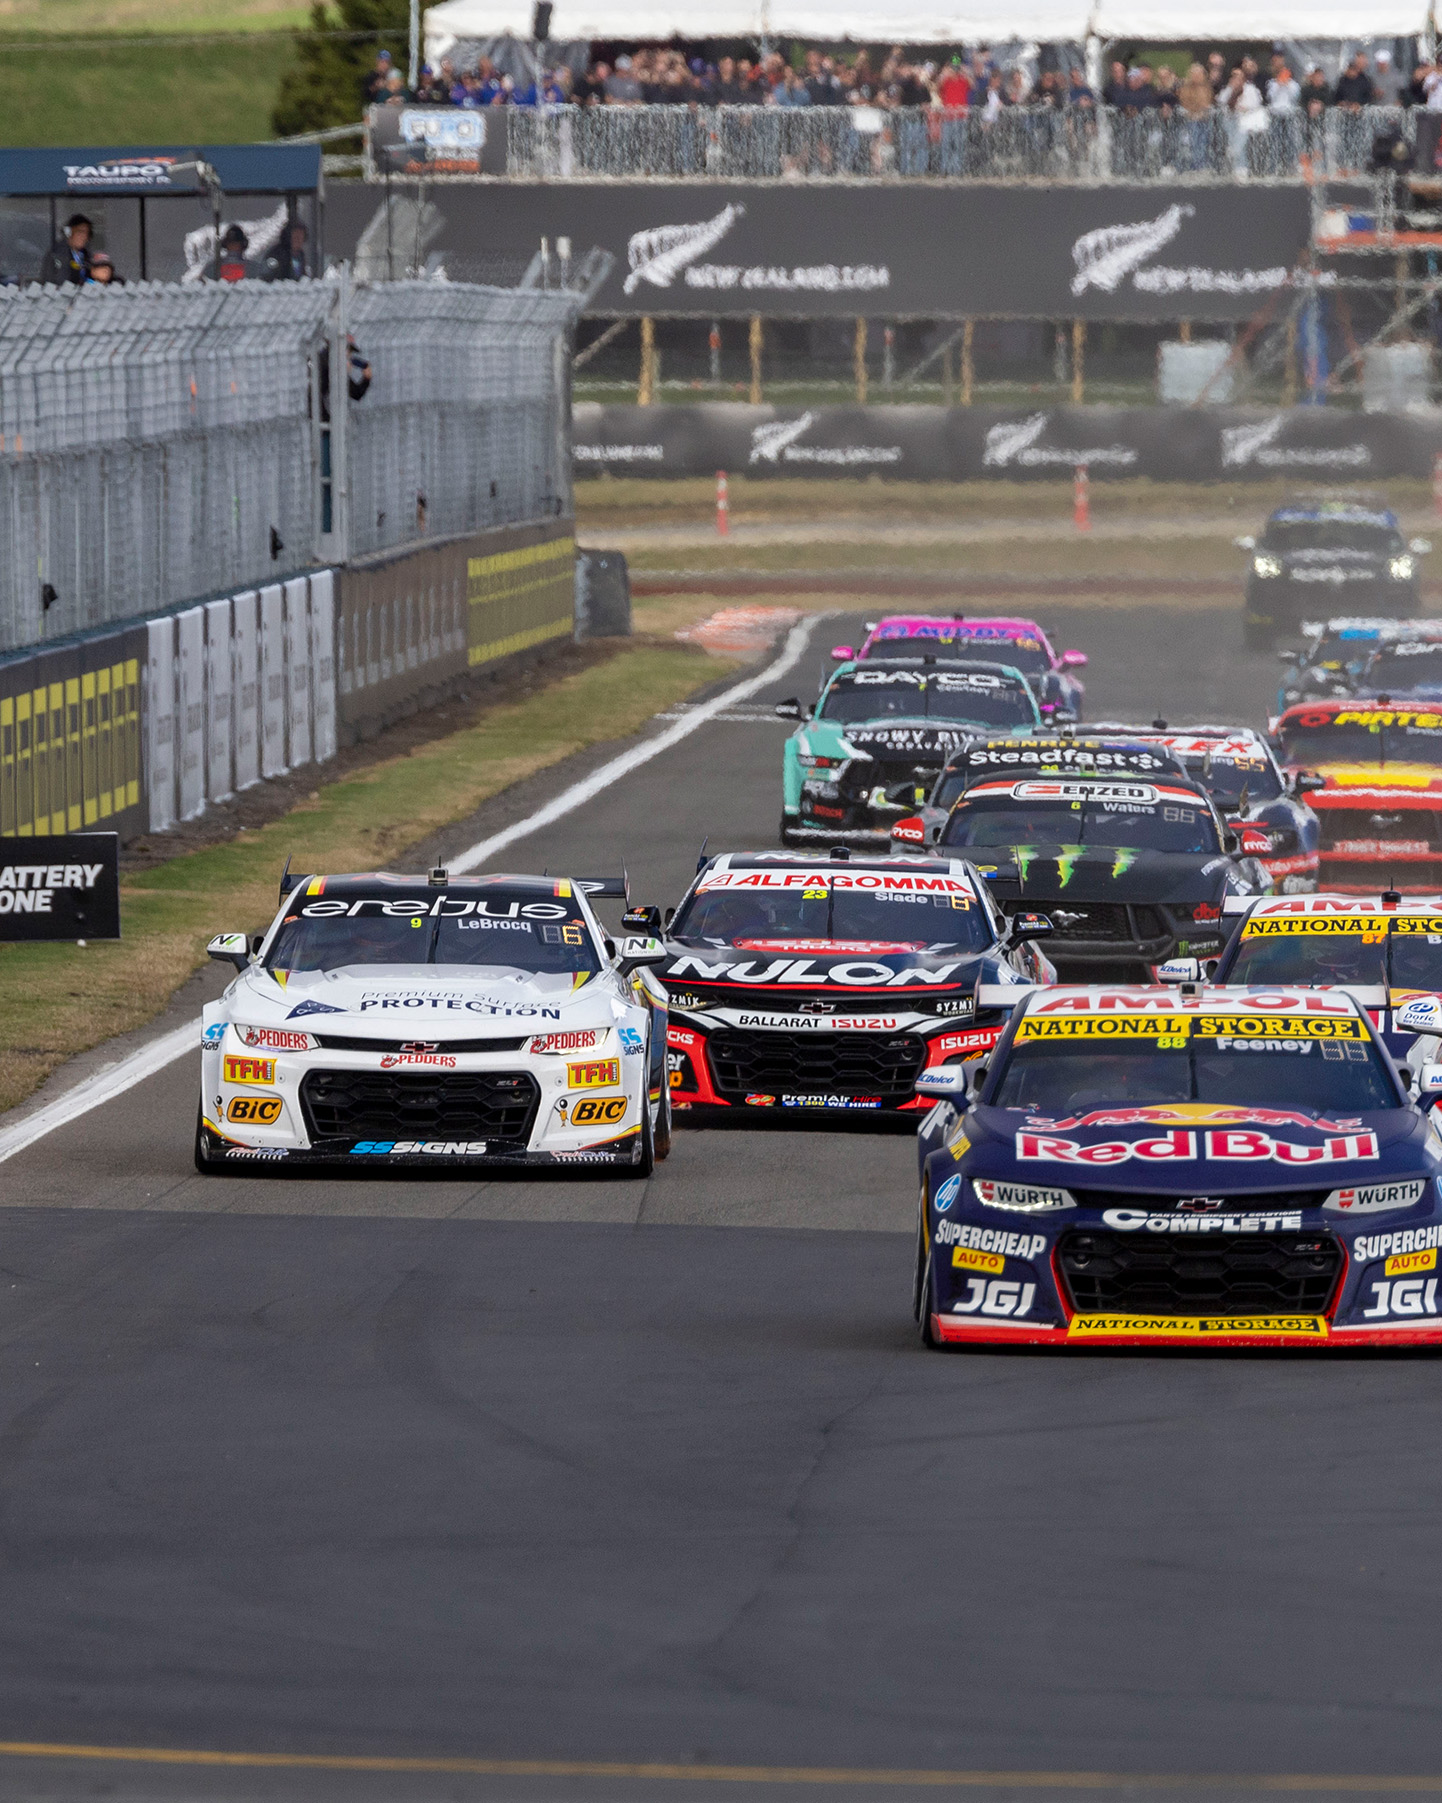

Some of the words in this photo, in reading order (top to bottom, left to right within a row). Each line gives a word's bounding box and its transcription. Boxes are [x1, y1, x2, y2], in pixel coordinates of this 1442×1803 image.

[968, 749, 1126, 767] Steadfast
[1063, 785, 1145, 798] ENZED
[1071, 801, 1080, 810] 6
[1102, 801, 1156, 815] Waters
[0, 864, 103, 889] ATTERY
[740, 873, 973, 894] ALFAGOMMA
[0, 890, 54, 913] ONE
[802, 889, 828, 900] 23
[875, 892, 928, 905] Slade
[302, 896, 568, 919] erebus
[411, 918, 422, 929] 9
[457, 918, 532, 934] LeBrocq
[1248, 919, 1382, 935] NATIONAL
[1362, 932, 1386, 944] 87
[667, 955, 961, 985] NULON
[361, 990, 464, 1001] Premium
[474, 992, 562, 1009] Surface
[936, 999, 974, 1013] SYZMI
[1035, 993, 1351, 1013] AMPOL
[360, 997, 561, 1021] PROTECTION
[1403, 1012, 1436, 1022] Doric
[739, 1015, 822, 1028] BALLARAT
[831, 1018, 897, 1029] ISUZU
[1022, 1017, 1188, 1038] NATIONAL
[1200, 1016, 1355, 1038] STORAGE
[260, 1029, 309, 1051] PEDDERS
[547, 1031, 596, 1050] PEDDERS
[618, 1028, 642, 1044] SS
[940, 1032, 991, 1050] ISUZU
[1157, 1037, 1187, 1049] 88
[1217, 1038, 1313, 1055] Feeney
[226, 1058, 268, 1079] TFH
[398, 1055, 457, 1068] PEDDERS
[571, 1062, 613, 1083] TFH
[852, 1094, 882, 1103] Hire
[1016, 1131, 1197, 1165] Red
[1205, 1131, 1379, 1165] Bull
[1103, 1208, 1301, 1232] COMPLETE
[935, 1218, 1047, 1261] SUPERCHEAP
[958, 1252, 998, 1268] AUTO
[1391, 1254, 1431, 1270] AUTO
[952, 1278, 1036, 1316] JGI
[1363, 1278, 1438, 1317] JGI
[1076, 1319, 1195, 1329] NATIONAL
[1205, 1319, 1315, 1331] STORAGE
